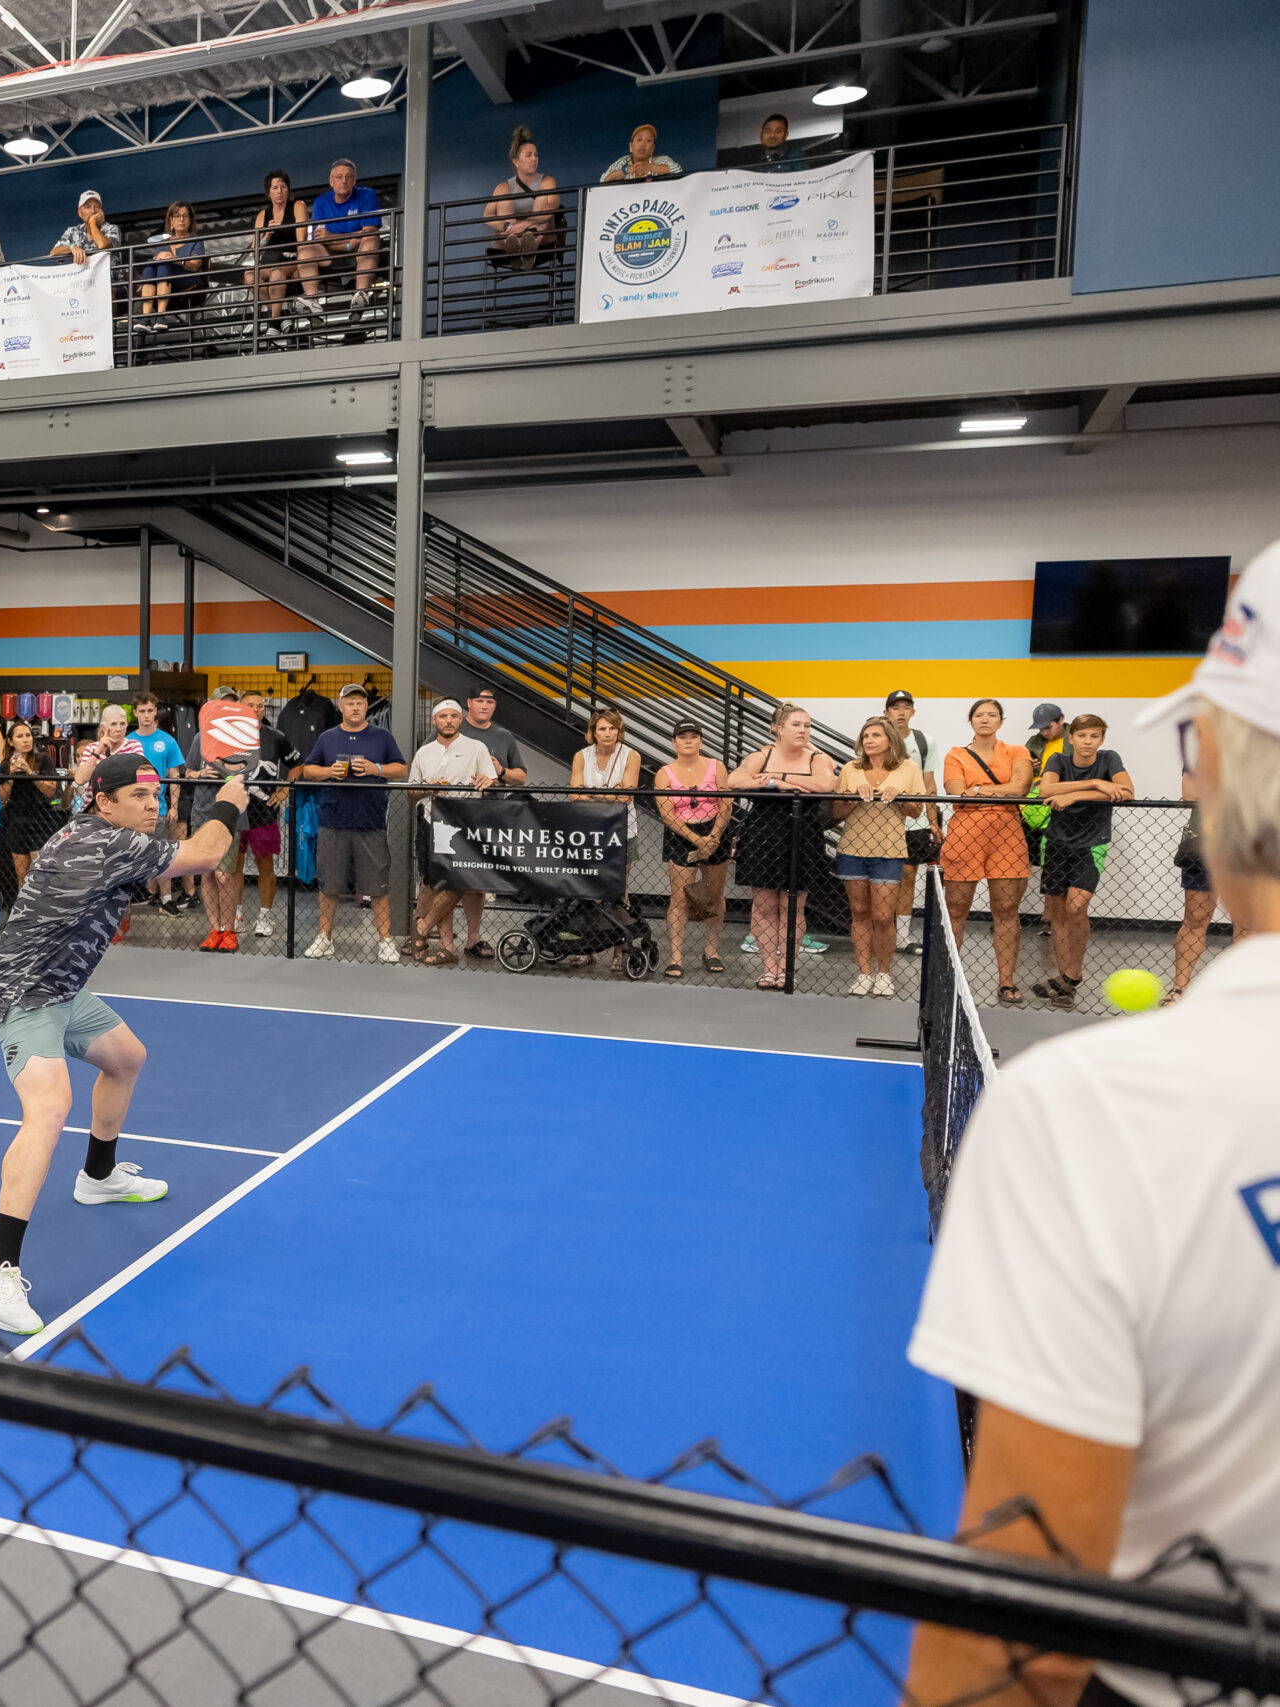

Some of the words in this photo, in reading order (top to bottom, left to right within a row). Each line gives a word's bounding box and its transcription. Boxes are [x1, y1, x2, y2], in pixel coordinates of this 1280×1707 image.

[808, 190, 860, 200] PIKKL
[642, 199, 685, 226] PADDLE
[709, 206, 734, 216] MAPLE
[735, 203, 759, 212] GROVE
[600, 207, 629, 241] PINTS
[615, 241, 641, 252] SLAM
[648, 238, 670, 248] JAM
[795, 277, 835, 286] Fredrikson
[619, 293, 644, 302] randy
[647, 291, 679, 300] shaver
[62, 350, 96, 360] Fredrikson
[466, 827, 623, 847] MINNESOTA
[482, 844, 526, 857] FINE
[535, 846, 605, 861] HOMES
[452, 861, 494, 870] DESIGNED
[496, 864, 511, 872] FOR
[512, 865, 533, 874] YOU,
[535, 866, 560, 875] BUILT
[562, 867, 579, 875] FOR
[581, 868, 599, 876] LIFE
